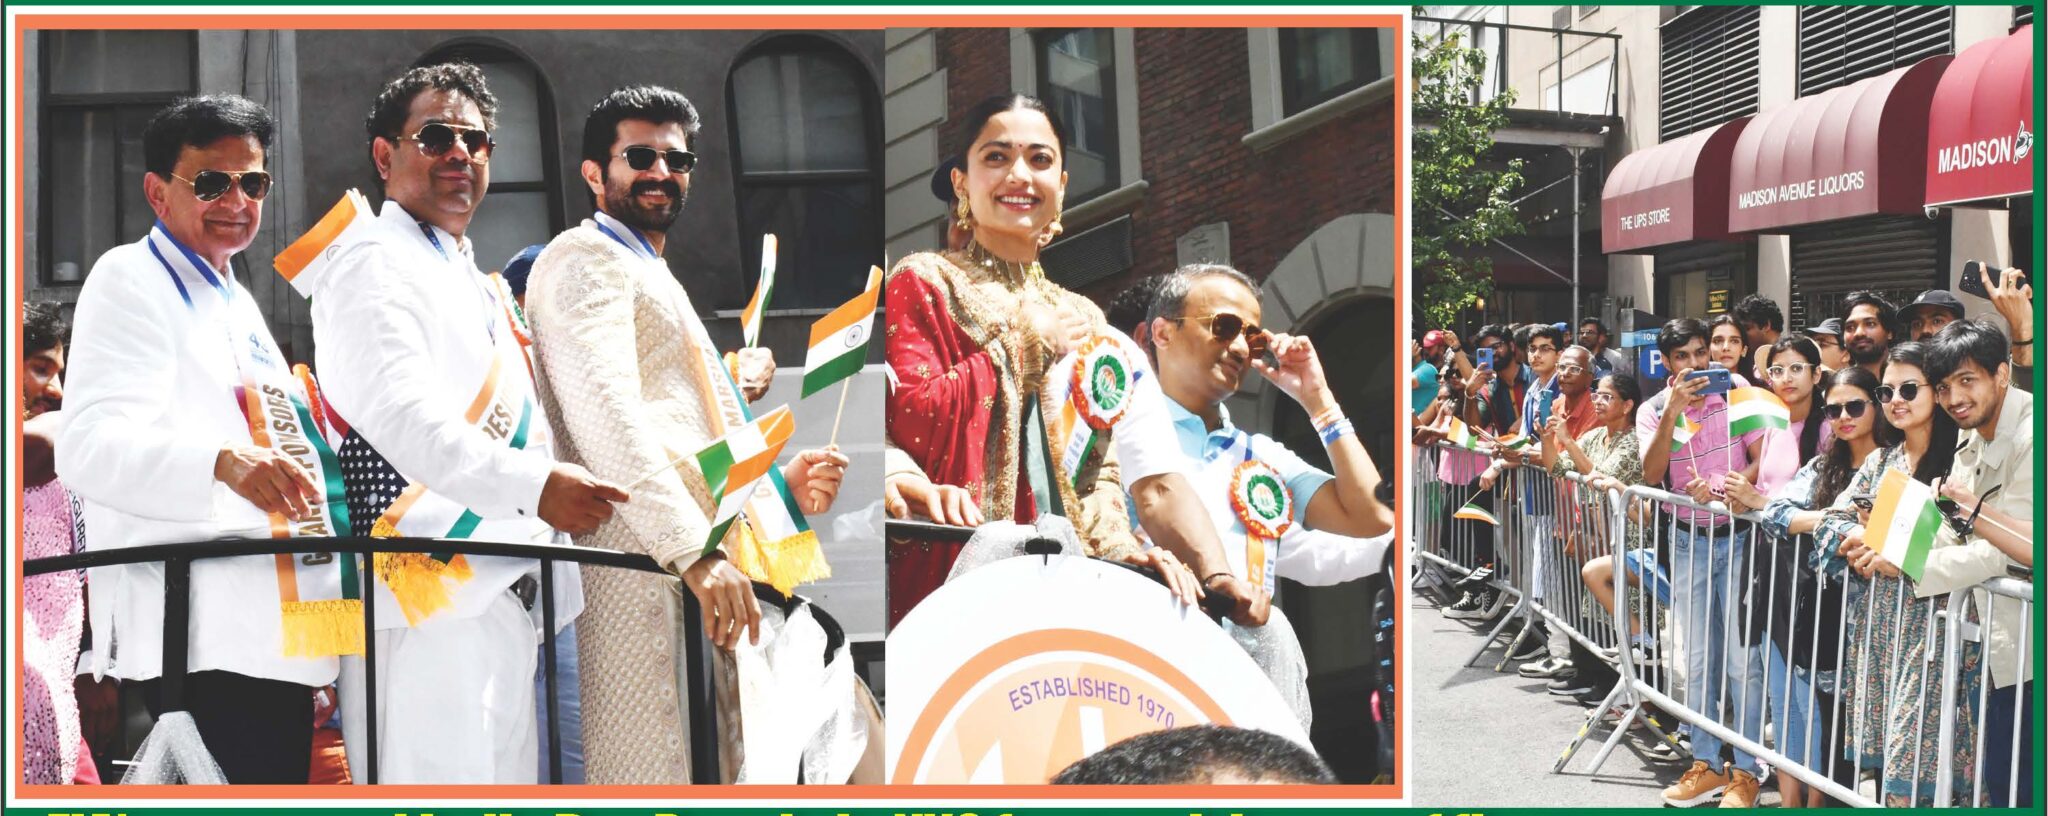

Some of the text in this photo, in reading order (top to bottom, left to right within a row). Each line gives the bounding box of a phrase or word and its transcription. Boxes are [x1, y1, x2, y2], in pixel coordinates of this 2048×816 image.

[1938, 134, 2012, 174] MADISON
[1738, 171, 1865, 210] MADISON AVENUE LIQUORS
[1621, 208, 1670, 230] THE UPS STORE
[1649, 349, 1662, 375] P
[1008, 677, 1175, 730] ESTABLISHED 1970
